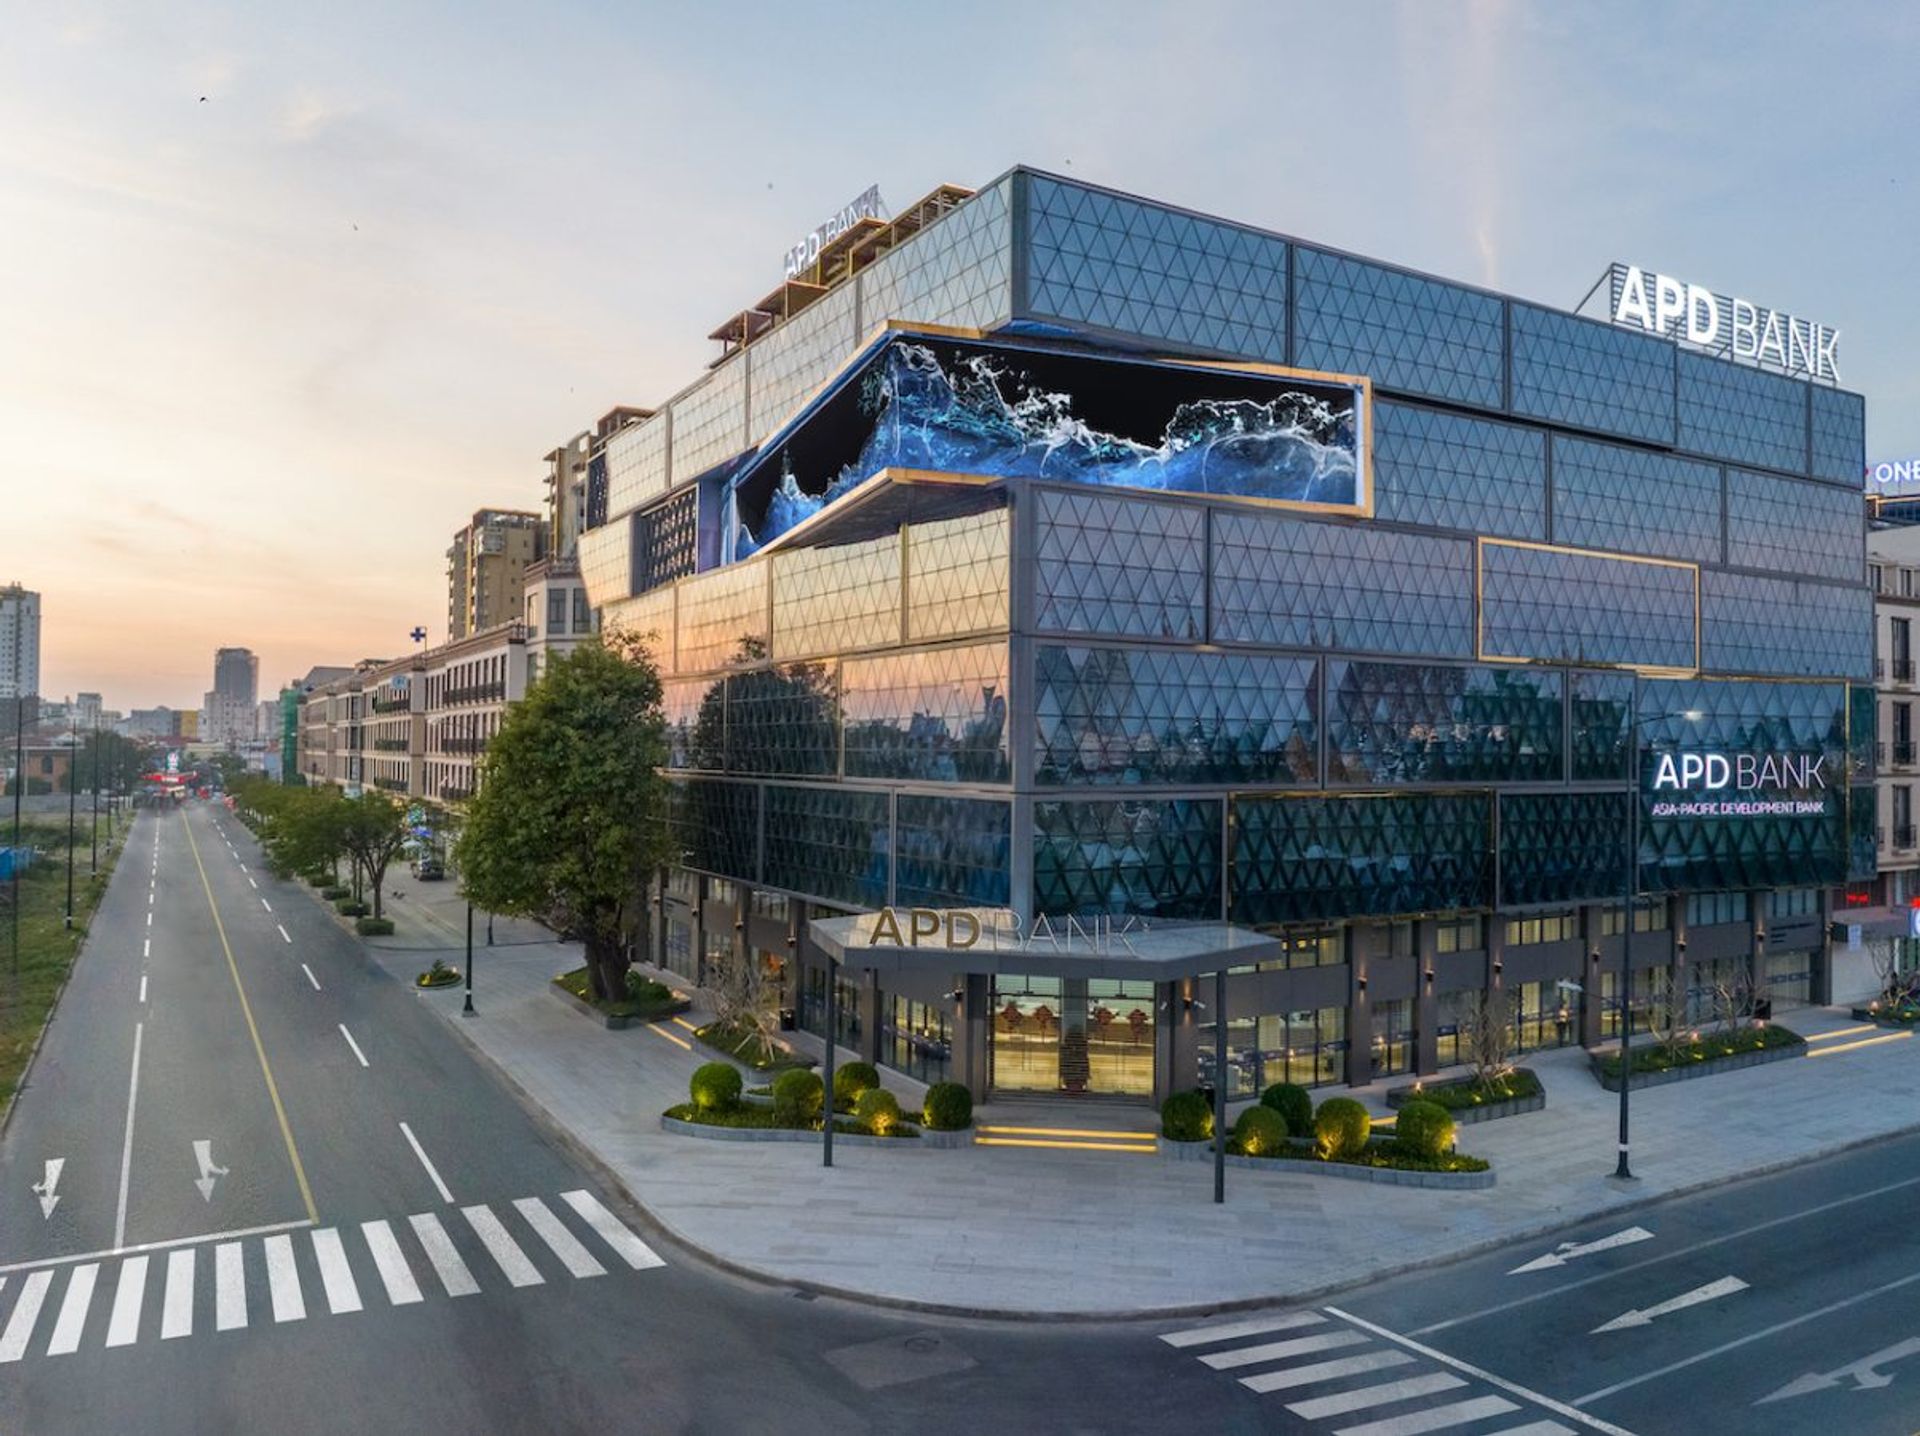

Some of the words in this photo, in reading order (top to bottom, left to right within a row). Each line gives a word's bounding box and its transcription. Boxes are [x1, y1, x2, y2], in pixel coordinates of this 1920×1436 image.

[1615, 266, 1717, 344] APD
[1732, 297, 1841, 381] BANK
[1653, 754, 1729, 790] APD
[1736, 754, 1826, 790] BANK
[1652, 803, 1719, 816] ASIA-PACIFIC
[1720, 802, 1795, 815] DEVELOPMENT
[1796, 801, 1824, 814] BANK
[869, 906, 982, 950] APD
[993, 911, 1140, 957] BANK
